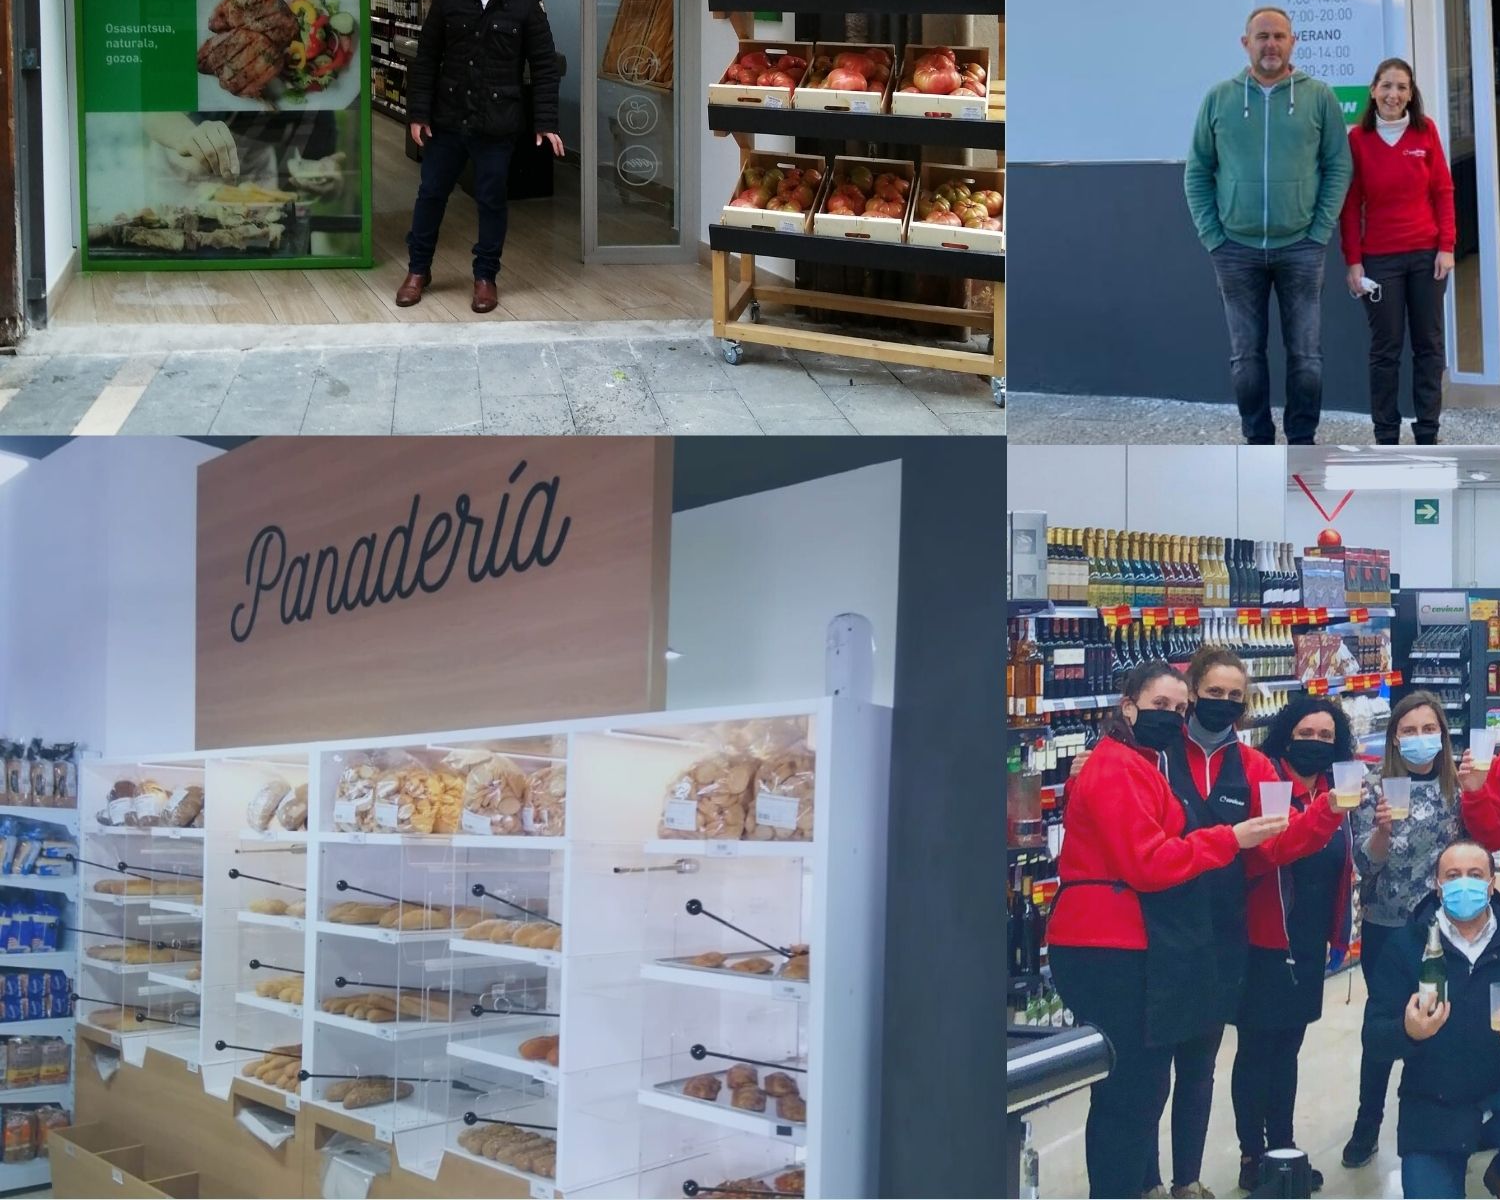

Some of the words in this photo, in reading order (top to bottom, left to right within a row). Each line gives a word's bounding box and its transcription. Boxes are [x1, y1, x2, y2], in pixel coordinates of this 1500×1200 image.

[106, 22, 176, 35] Osasuntsua,
[1293, 29, 1342, 42] VERANO
[106, 38, 158, 49] naturala,
[106, 55, 143, 66] gozoa.
[230, 460, 571, 643] Panadería
